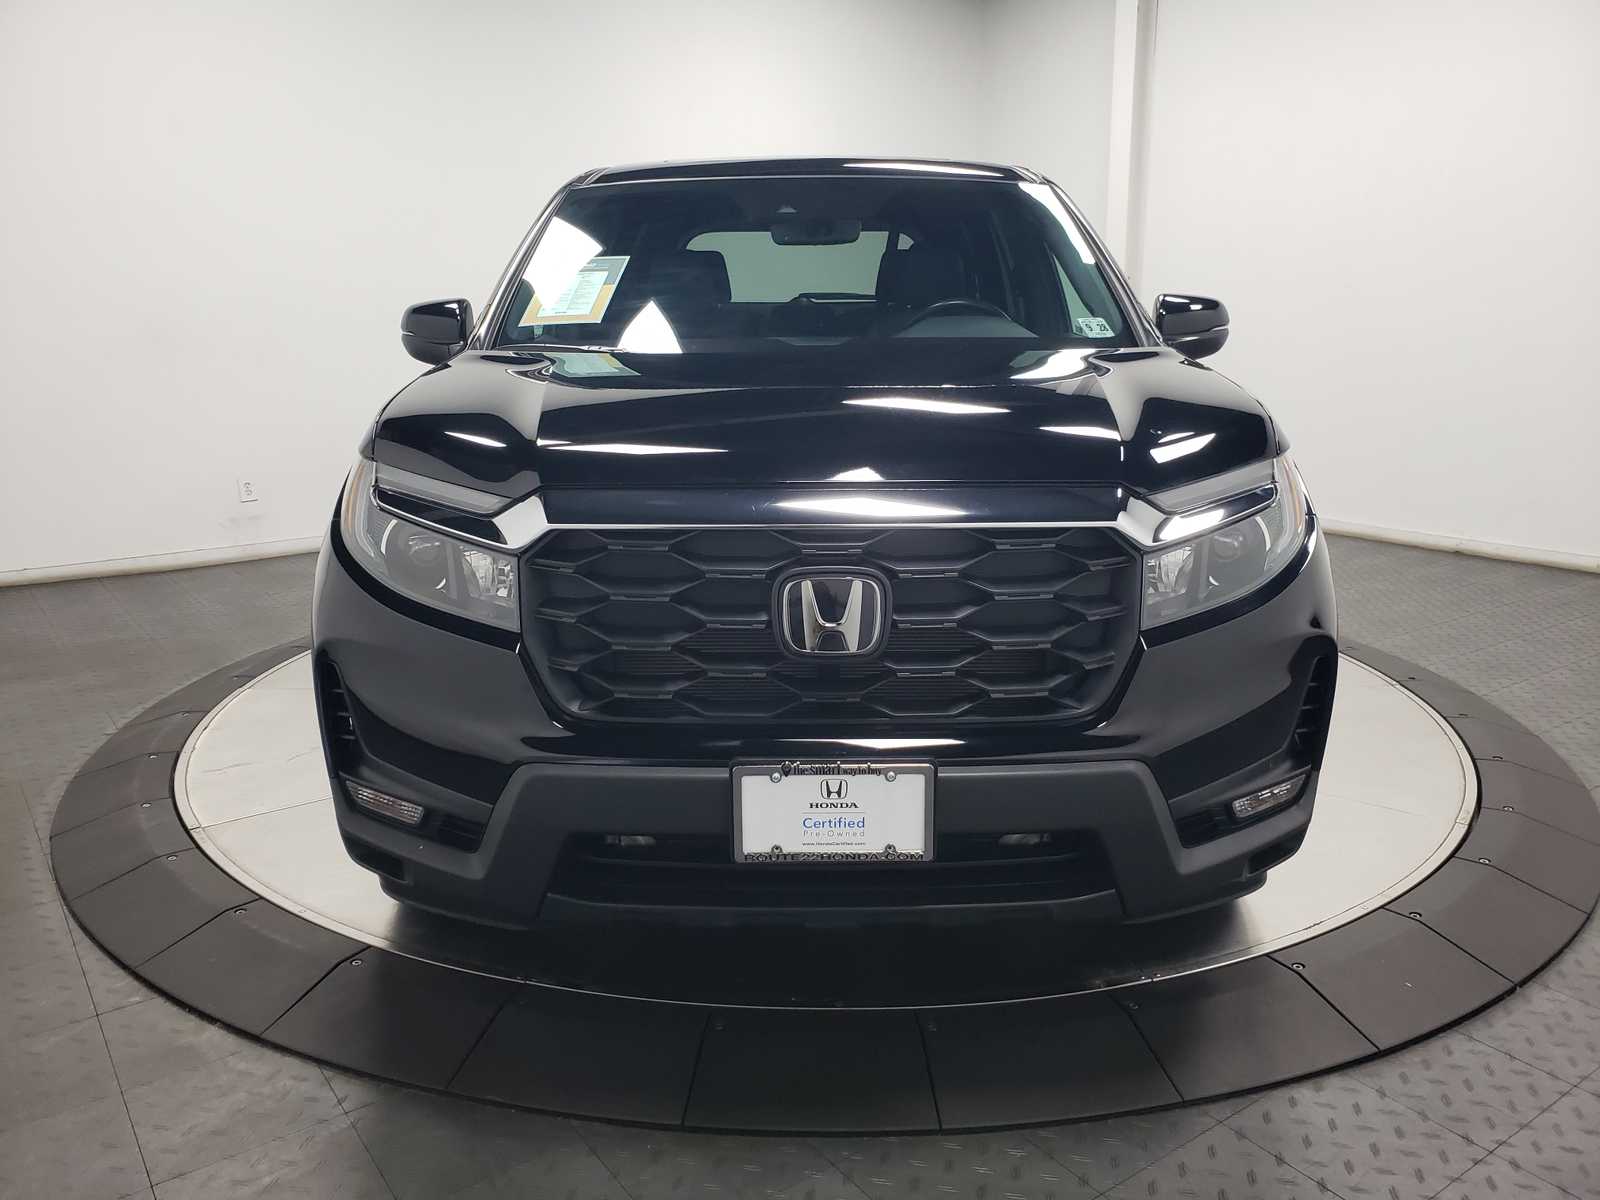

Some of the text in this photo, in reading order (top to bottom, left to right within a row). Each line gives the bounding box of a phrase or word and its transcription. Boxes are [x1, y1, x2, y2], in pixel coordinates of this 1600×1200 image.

[1085, 323, 1093, 331] 9
[810, 761, 841, 775] smart
[843, 767, 857, 776] way
[803, 817, 865, 828] Certified
[745, 853, 923, 861] ROUTE22HONDA.COM
